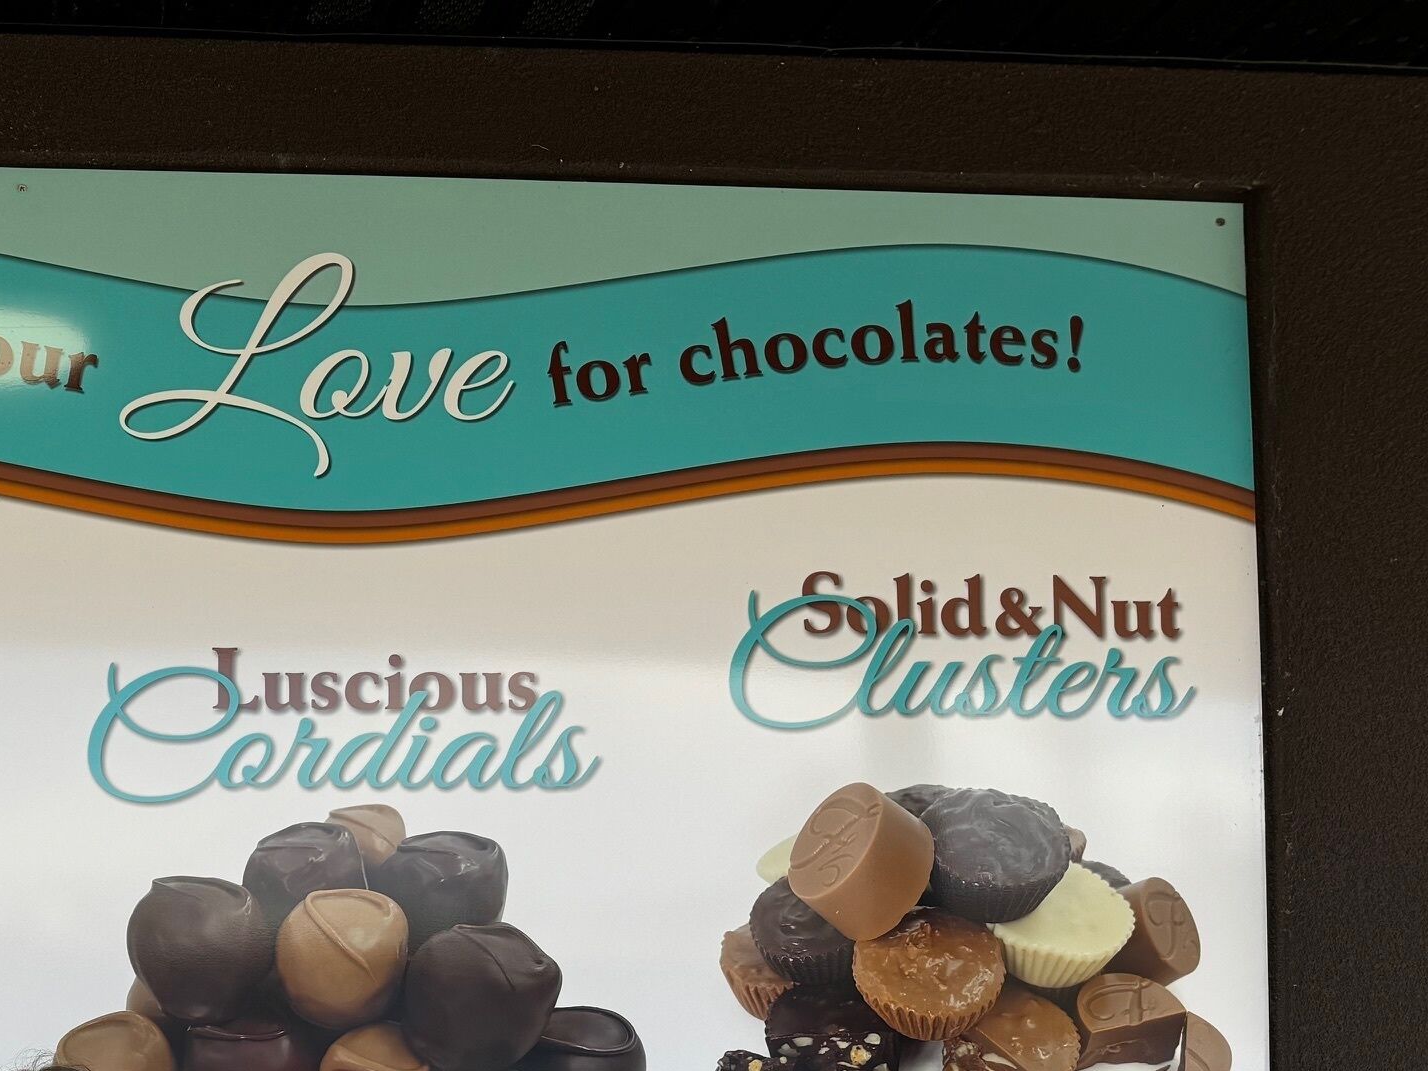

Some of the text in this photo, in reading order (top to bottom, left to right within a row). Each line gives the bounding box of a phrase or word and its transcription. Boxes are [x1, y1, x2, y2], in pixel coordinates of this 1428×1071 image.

[119, 252, 515, 477] Love
[547, 340, 652, 407] for
[679, 300, 1085, 386] chocolates!
[212, 646, 537, 714] Luscious
[728, 589, 1197, 730] Clusters
[87, 661, 601, 803] Cordials
